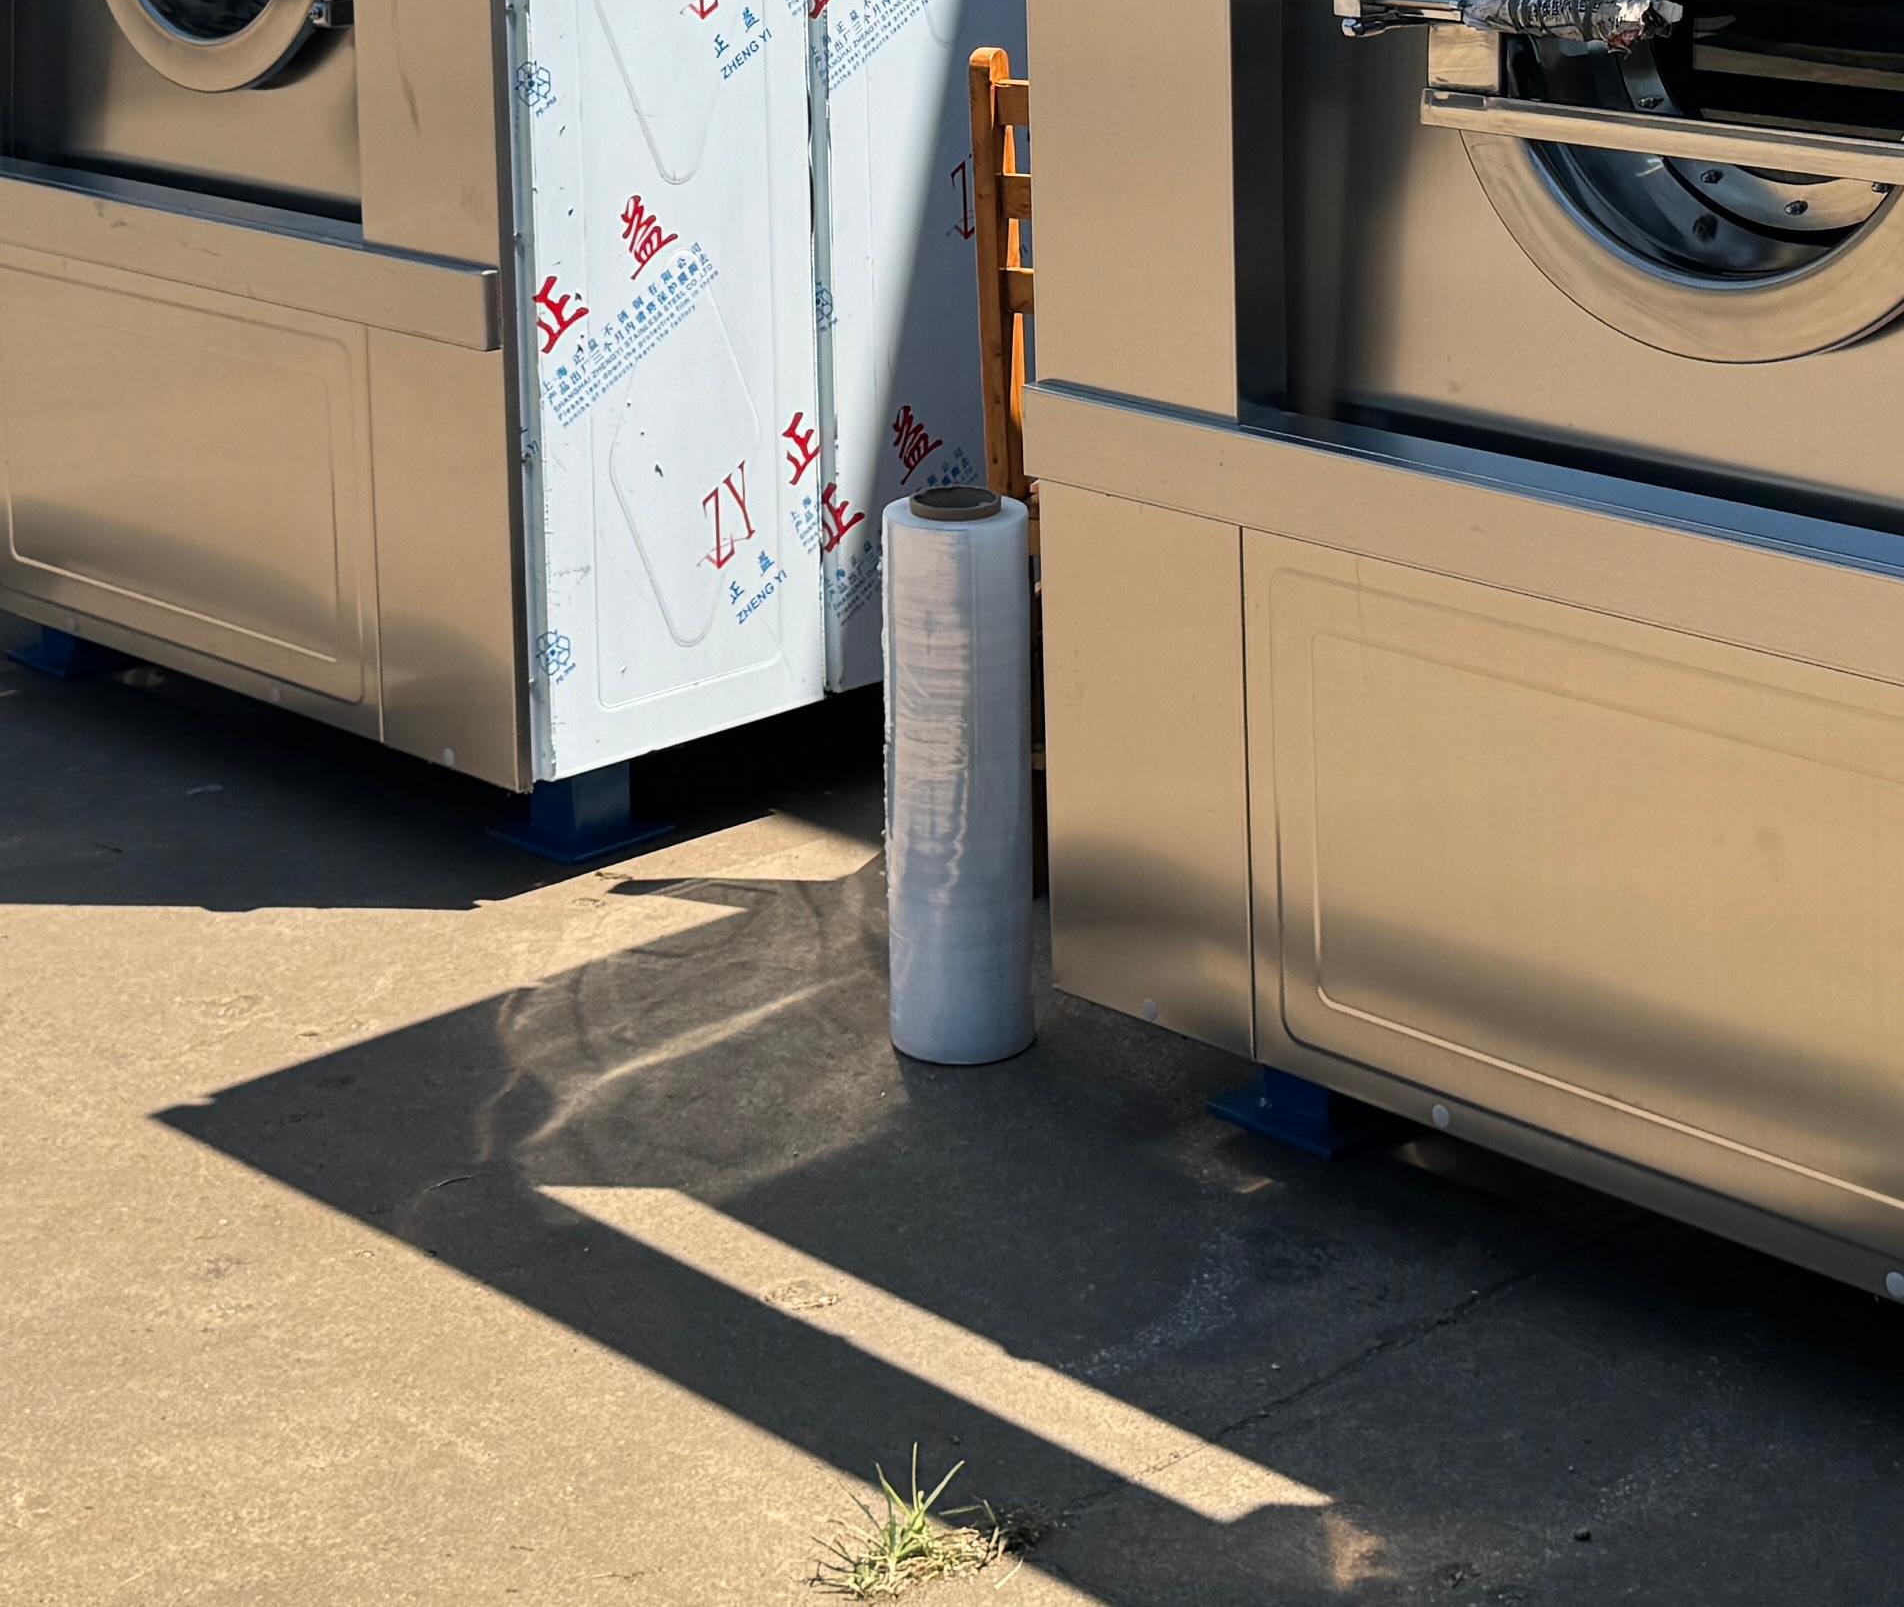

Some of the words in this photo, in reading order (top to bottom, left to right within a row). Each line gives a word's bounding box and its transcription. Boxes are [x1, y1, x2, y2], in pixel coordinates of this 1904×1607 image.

[721, 40, 759, 80] ZHENG
[759, 28, 773, 49] YI
[698, 461, 757, 569] ZY
[736, 583, 773, 625] ZHENG
[771, 568, 788, 590] YI
